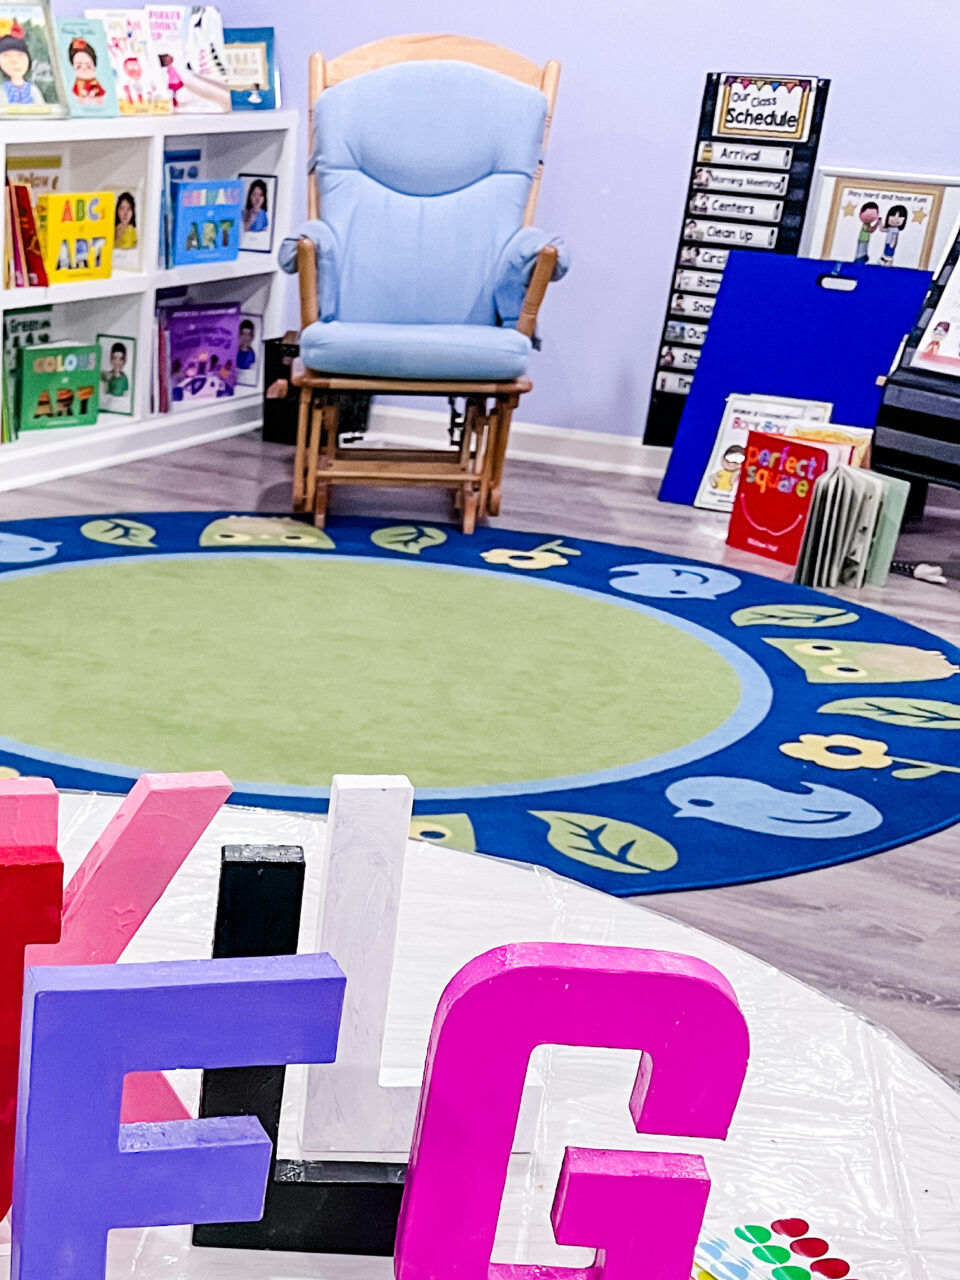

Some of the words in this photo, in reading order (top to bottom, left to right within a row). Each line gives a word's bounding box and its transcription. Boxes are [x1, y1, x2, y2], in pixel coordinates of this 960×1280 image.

[730, 91, 751, 103] Our
[750, 95, 778, 108] Class
[725, 107, 800, 128] Schedule
[720, 148, 761, 162] Arrival
[711, 200, 755, 215] Centers
[706, 226, 736, 239] Clean
[740, 230, 754, 244] Up
[55, 236, 107, 271] ART
[33, 385, 95, 420] ART
[746, 445, 818, 481] perfect
[745, 465, 810, 498] square
